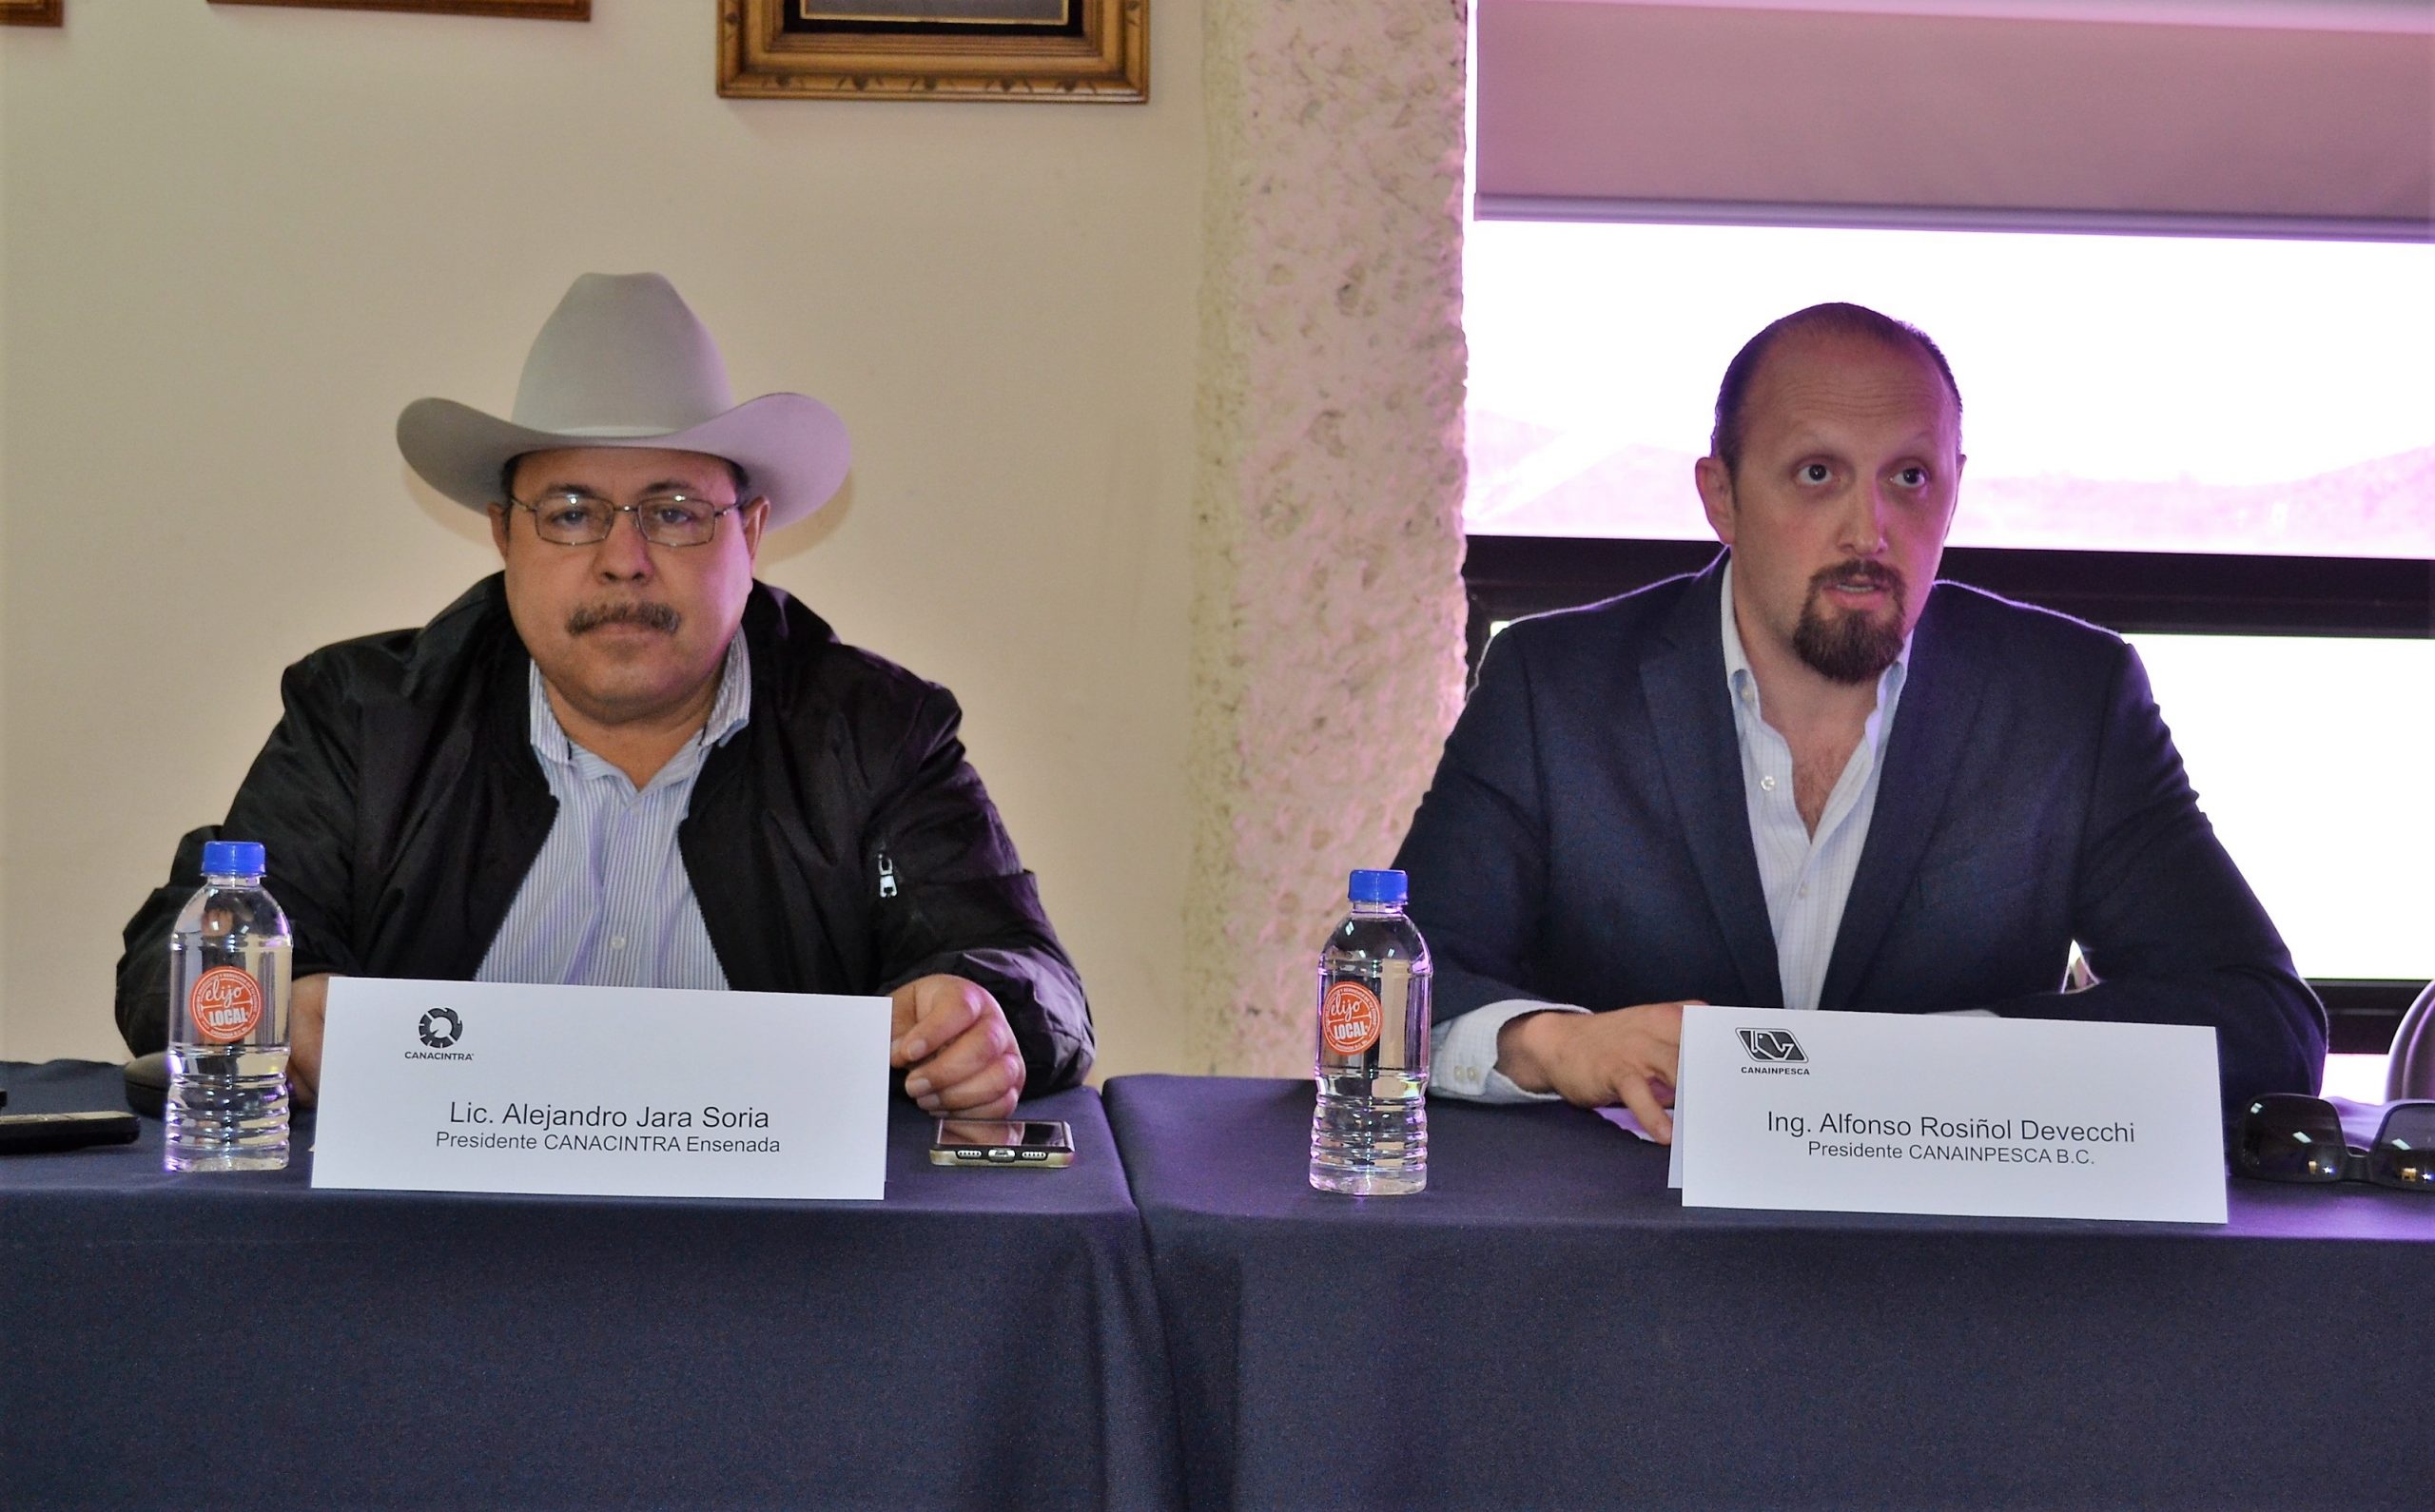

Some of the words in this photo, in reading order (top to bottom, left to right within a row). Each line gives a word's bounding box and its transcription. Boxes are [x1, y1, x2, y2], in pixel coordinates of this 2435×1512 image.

[208, 1007, 248, 1027] LOCAL
[1334, 1020, 1368, 1041] LOCAL
[404, 1051, 473, 1061] CANACINTRA
[1741, 1066, 1810, 1076] CANAINPESCA
[450, 1101, 494, 1124] Lic.
[501, 1102, 628, 1132] Alejandro
[635, 1106, 692, 1128] Jara
[702, 1106, 769, 1129] Soria
[1768, 1111, 1811, 1138] Ing.
[1819, 1113, 1912, 1136] Alfonso
[1920, 1116, 2012, 1140] Rosiñol
[2021, 1119, 2134, 1143] Devecchi
[436, 1131, 537, 1150] Presidente
[544, 1134, 681, 1153] CANACINTRA
[687, 1135, 780, 1153] Ensenada
[1808, 1140, 1903, 1159] Presidente
[1909, 1144, 2053, 1164] CANAINPESCA
[2056, 1148, 2094, 1165] B.C.
